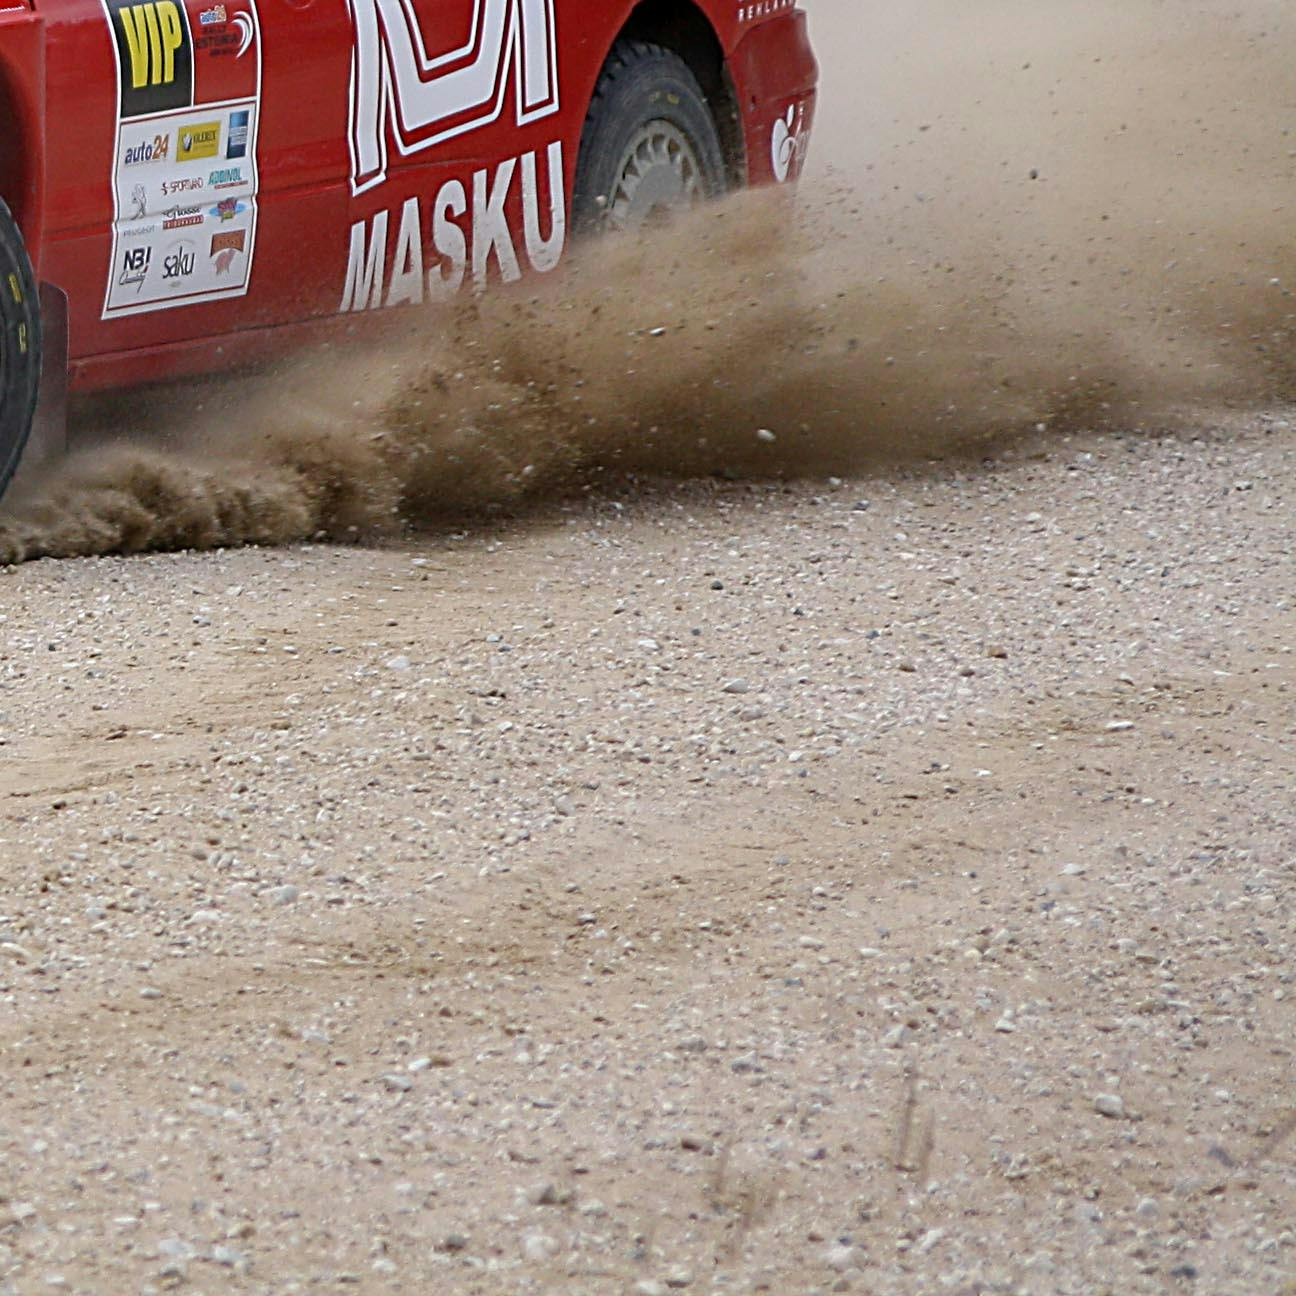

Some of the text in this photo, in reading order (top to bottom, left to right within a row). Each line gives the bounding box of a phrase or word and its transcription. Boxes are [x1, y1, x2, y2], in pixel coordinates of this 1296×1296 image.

[119, 0, 182, 88] VIP
[124, 134, 170, 165] auto24
[339, 141, 566, 312] MASKU
[162, 246, 195, 279] saku
